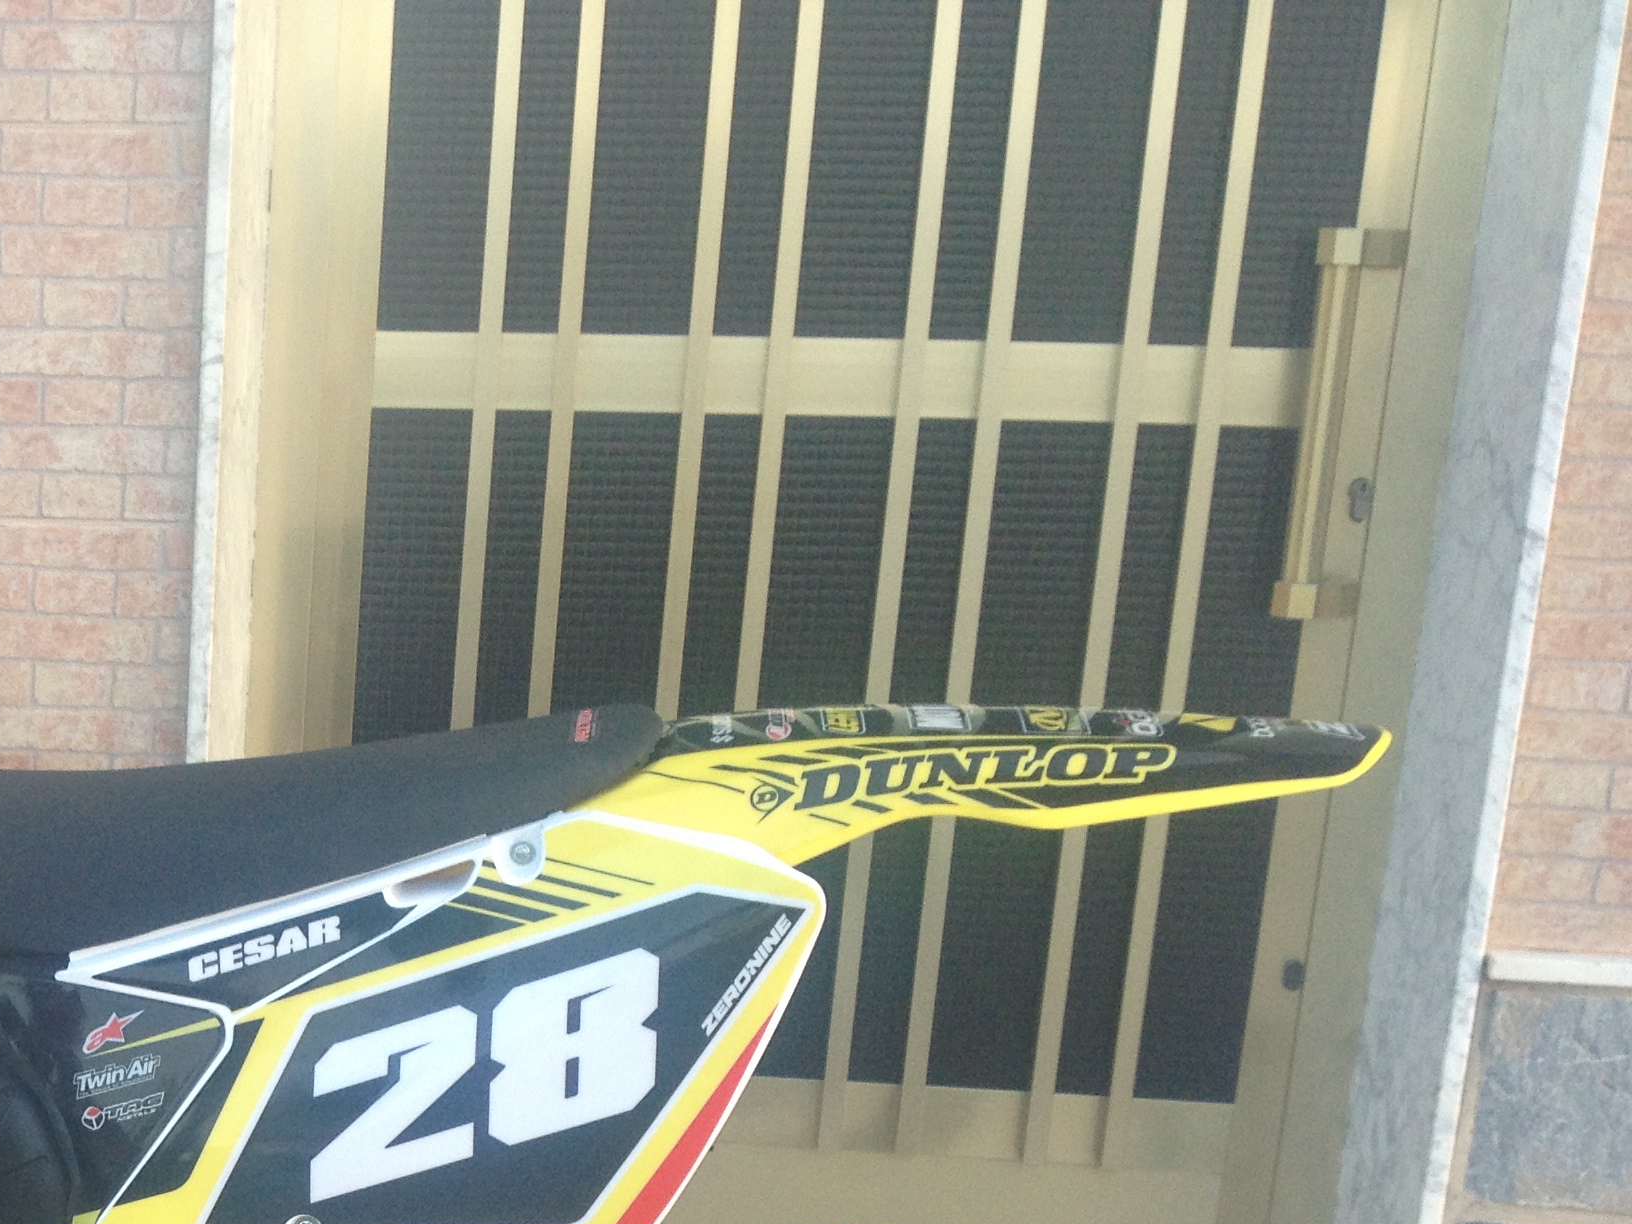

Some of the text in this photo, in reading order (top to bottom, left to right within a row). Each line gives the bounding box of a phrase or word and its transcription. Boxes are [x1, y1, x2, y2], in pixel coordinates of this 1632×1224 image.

[794, 744, 1176, 812] DUNLOP
[187, 913, 342, 984] CESAR
[701, 913, 793, 1038] ZERONINE
[76, 1062, 126, 1092] Twin
[126, 1054, 157, 1080] Air
[310, 948, 659, 1204] 28
